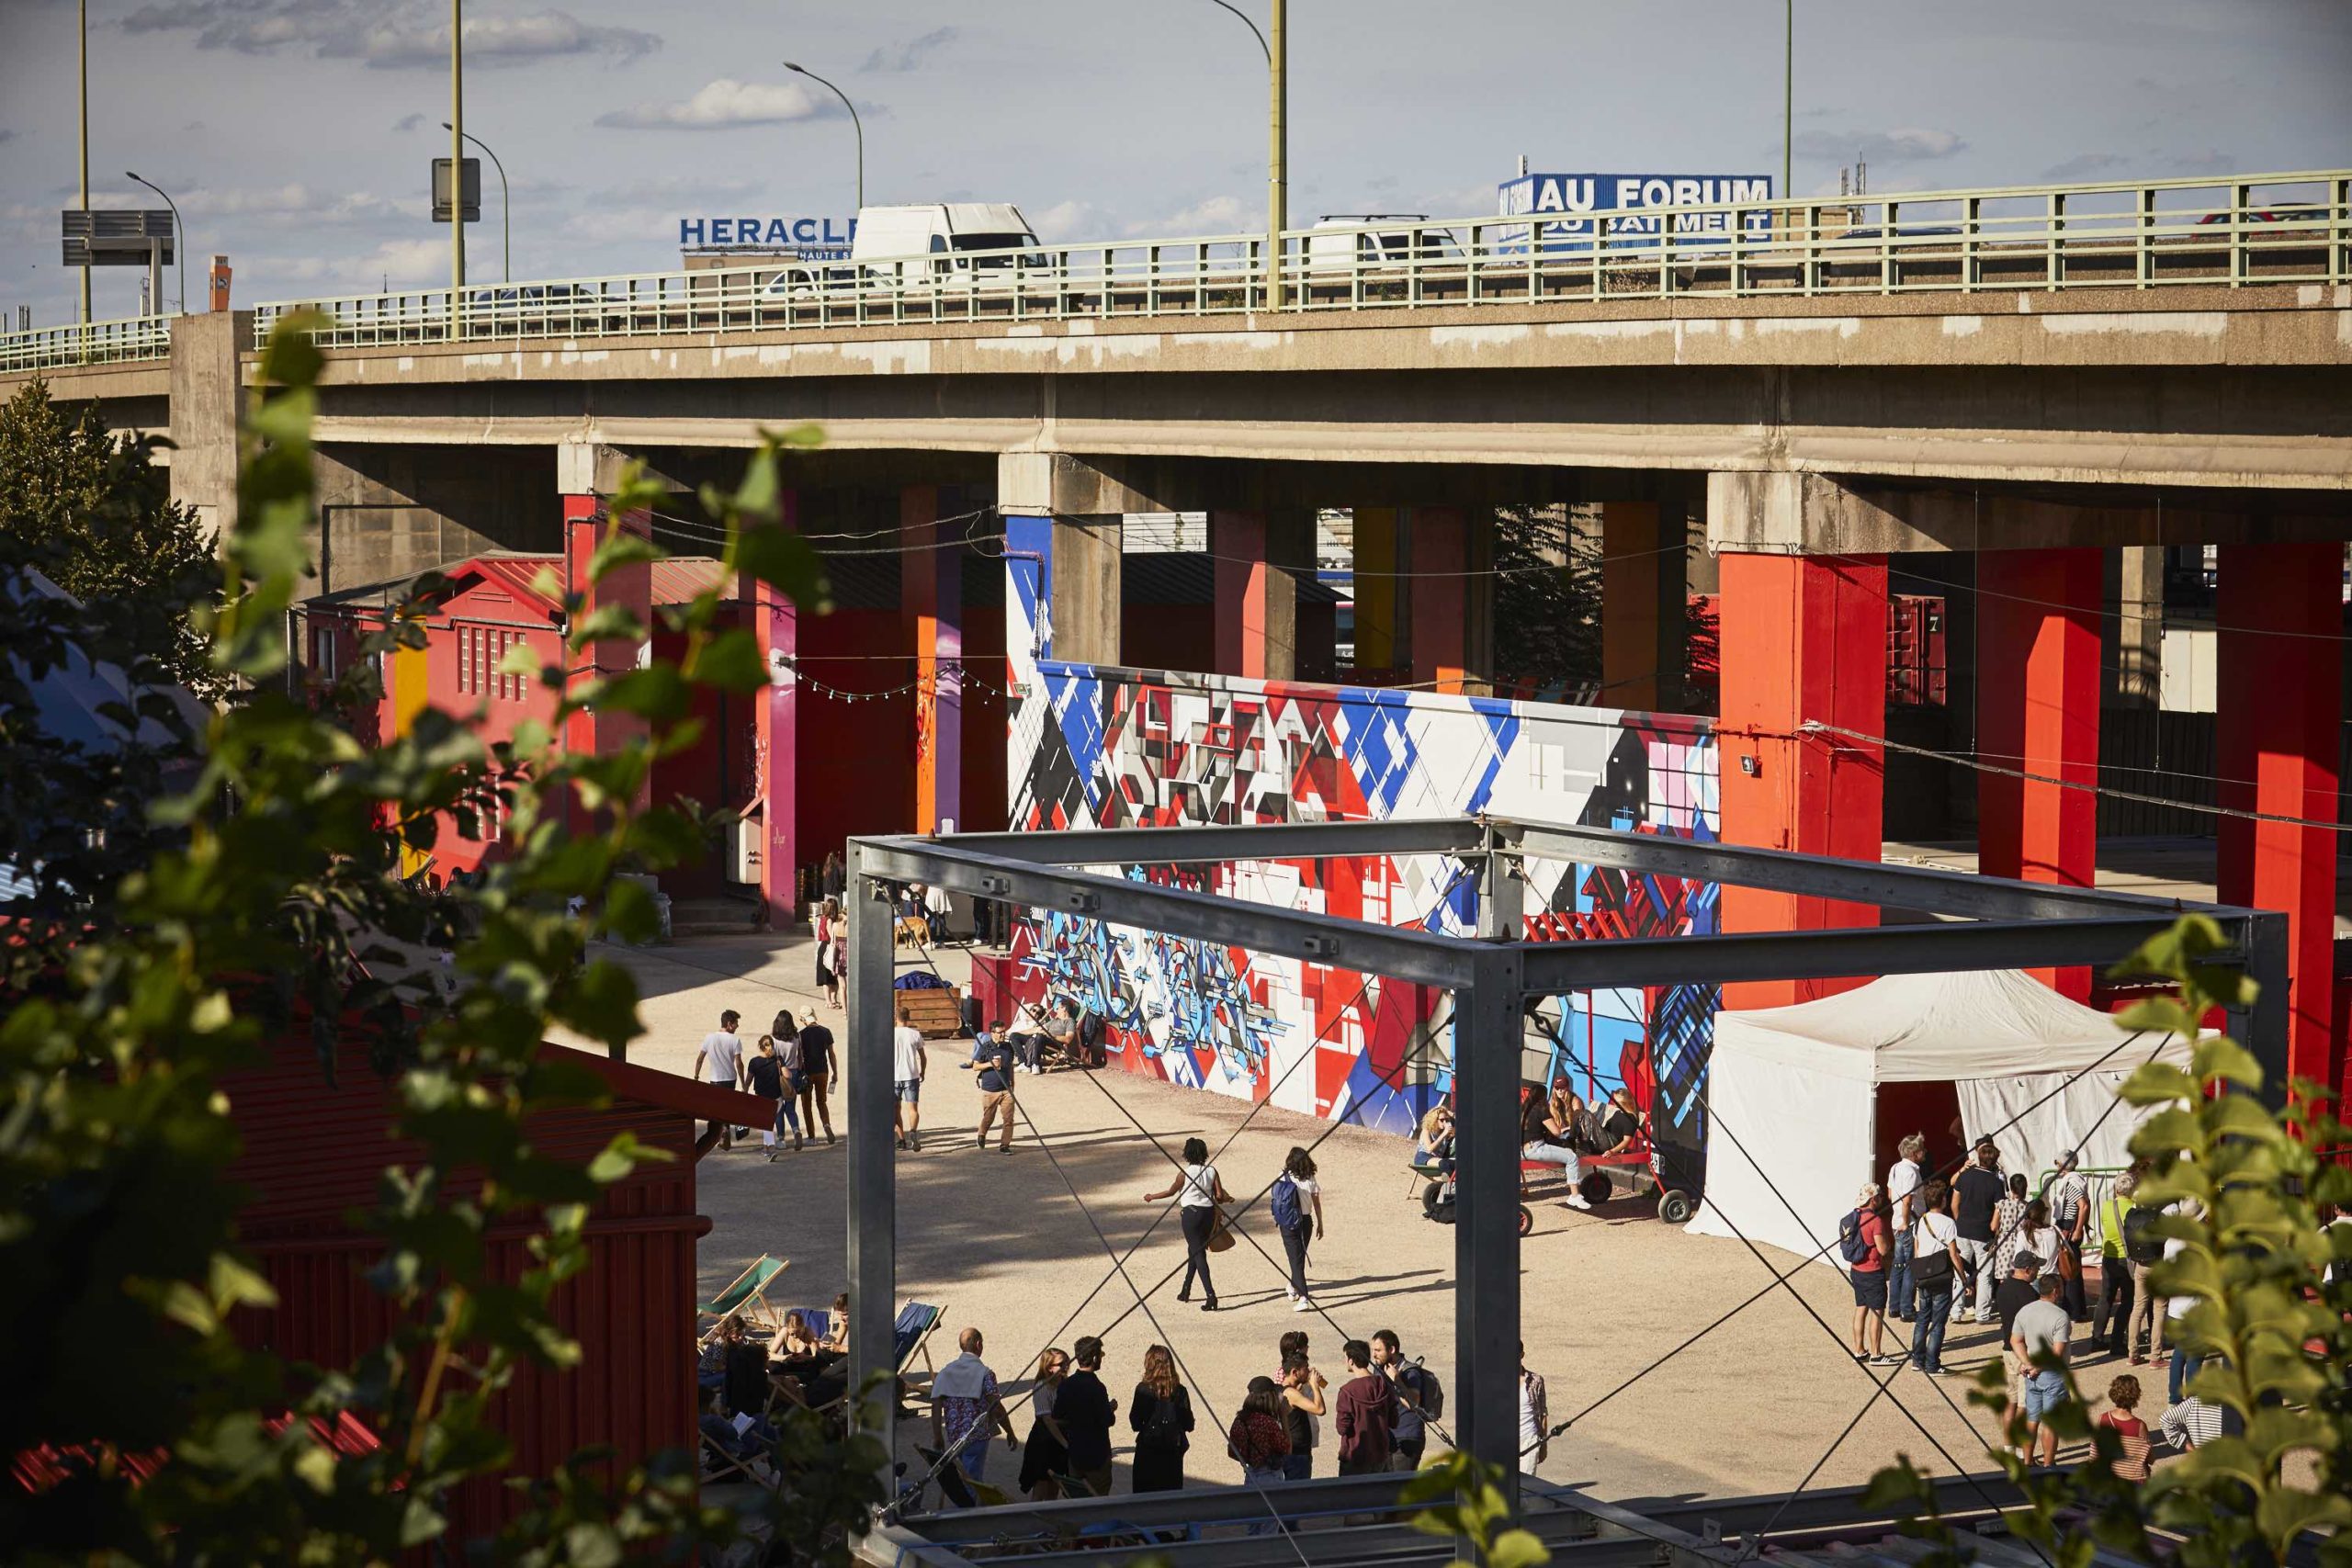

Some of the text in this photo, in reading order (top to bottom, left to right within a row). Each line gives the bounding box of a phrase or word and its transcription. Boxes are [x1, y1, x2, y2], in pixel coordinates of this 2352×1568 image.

[1537, 179, 1594, 212] AU
[1618, 179, 1768, 211] FORUM
[1608, 214, 1768, 231] ATMET
[799, 251, 837, 260] HAUTE
[1929, 616, 1939, 632] 7
